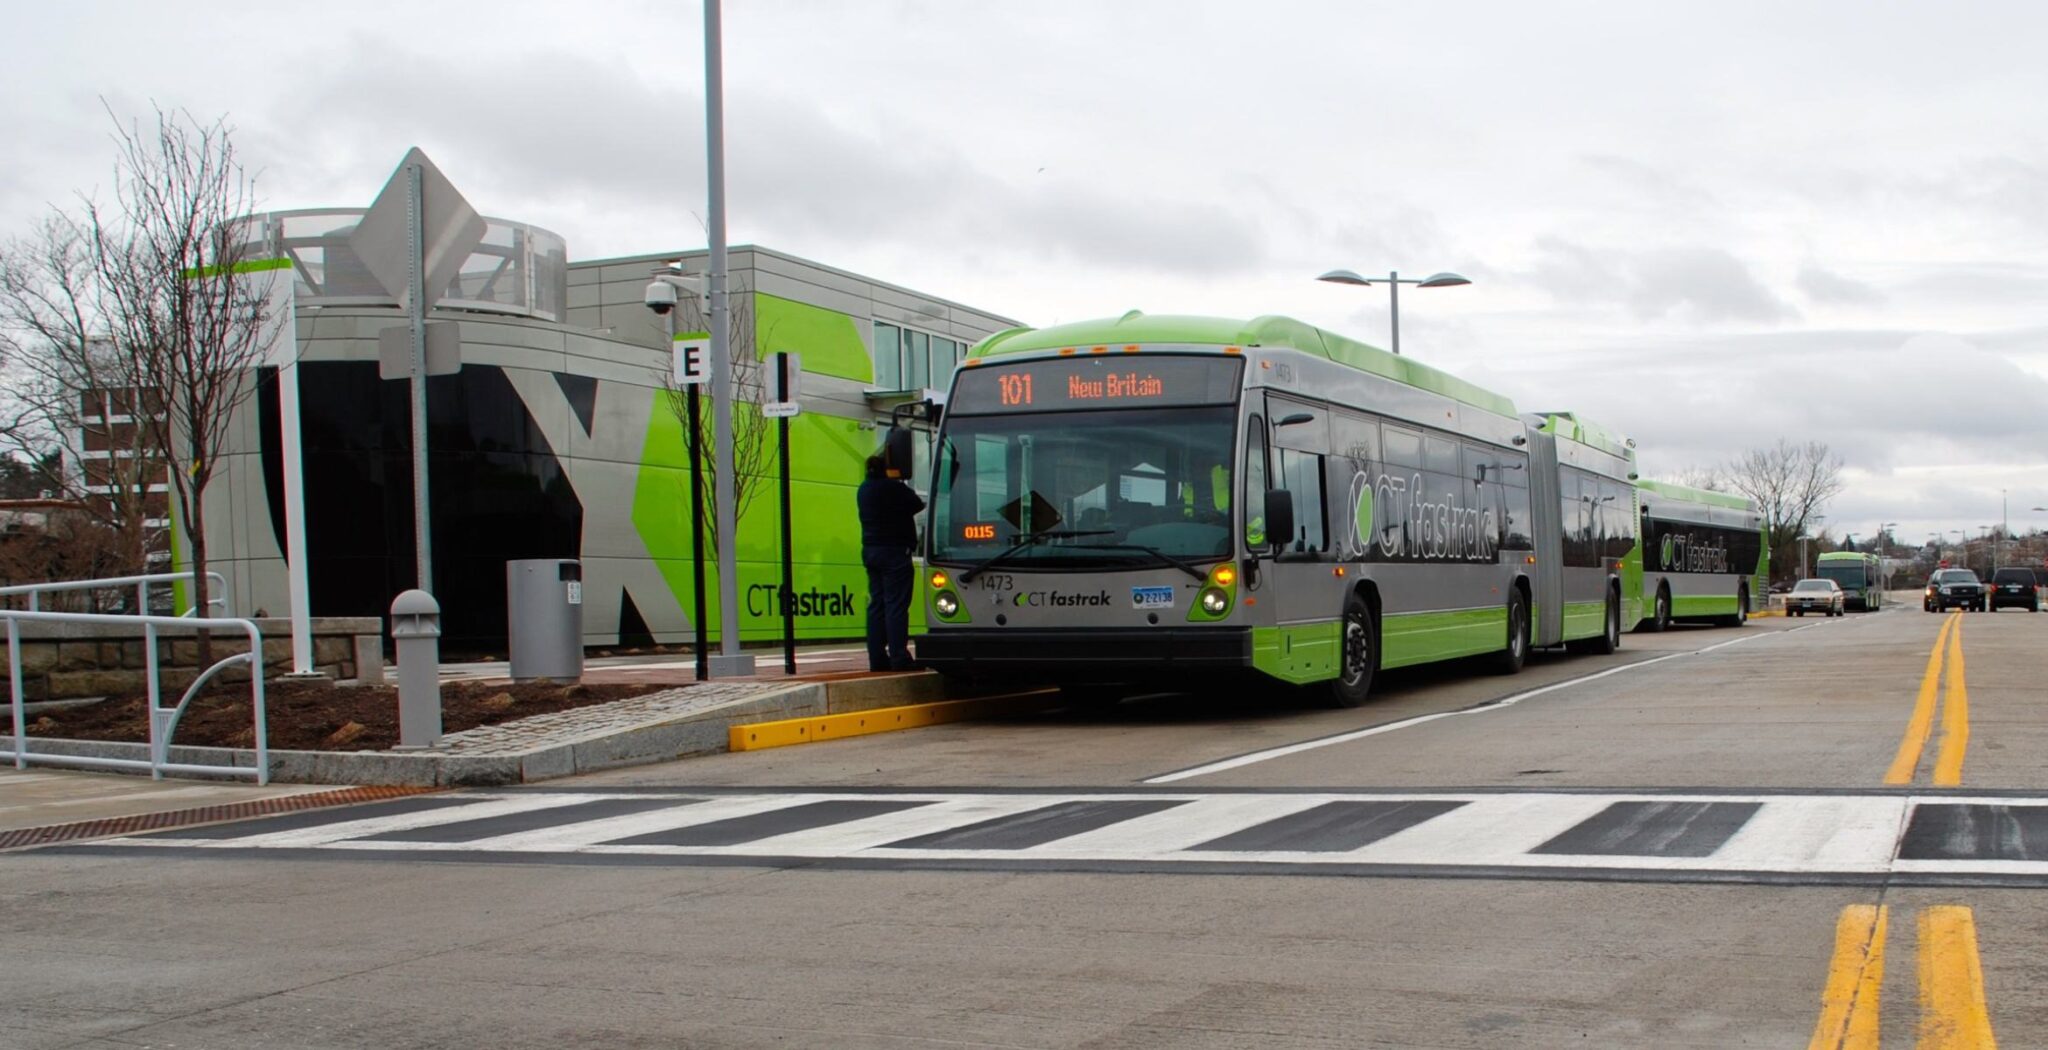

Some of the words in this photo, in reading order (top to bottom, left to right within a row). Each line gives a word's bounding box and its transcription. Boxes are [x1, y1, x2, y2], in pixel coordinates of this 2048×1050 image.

[684, 347, 700, 376] E
[998, 374, 1032, 405] 101
[1068, 375, 1102, 399] New
[1106, 373, 1162, 397] Britain
[1374, 474, 1406, 557] CT
[1410, 472, 1492, 560] fastrak
[964, 525, 995, 539] 0115
[980, 575, 1014, 591] 1473
[1050, 590, 1111, 606] fastrak
